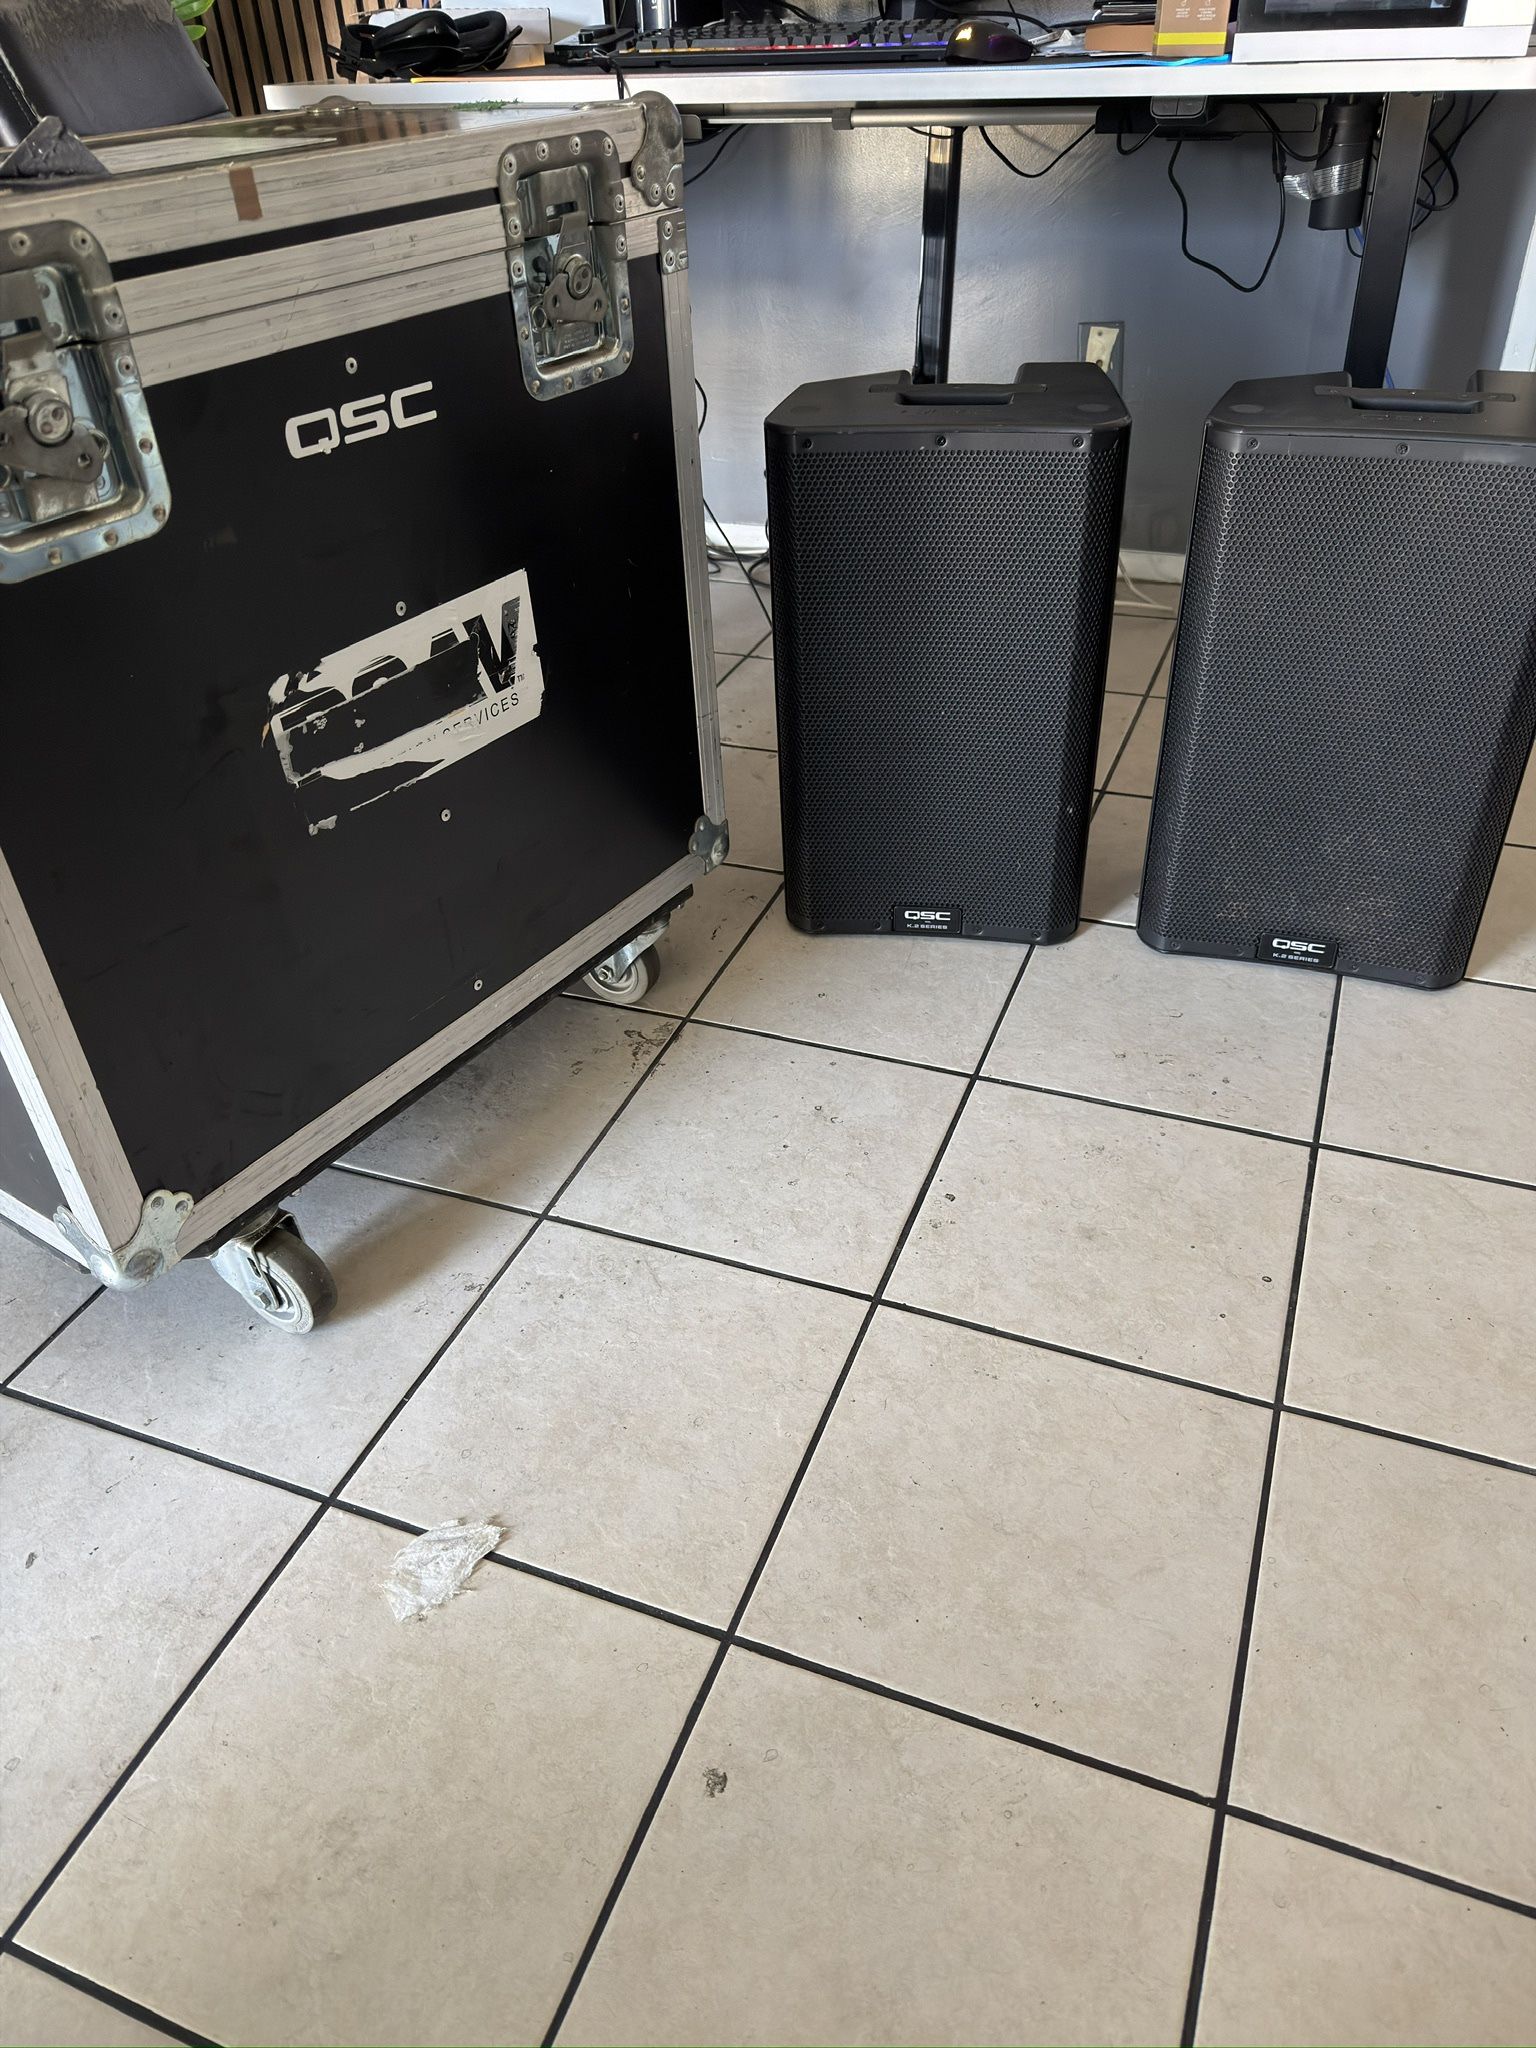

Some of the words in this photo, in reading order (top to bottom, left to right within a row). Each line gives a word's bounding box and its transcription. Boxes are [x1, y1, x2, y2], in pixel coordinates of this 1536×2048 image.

[285, 381, 438, 459] QSC
[904, 910, 951, 921] QSC
[1272, 938, 1326, 953] QSC
[1287, 955, 1319, 963] SERIES
